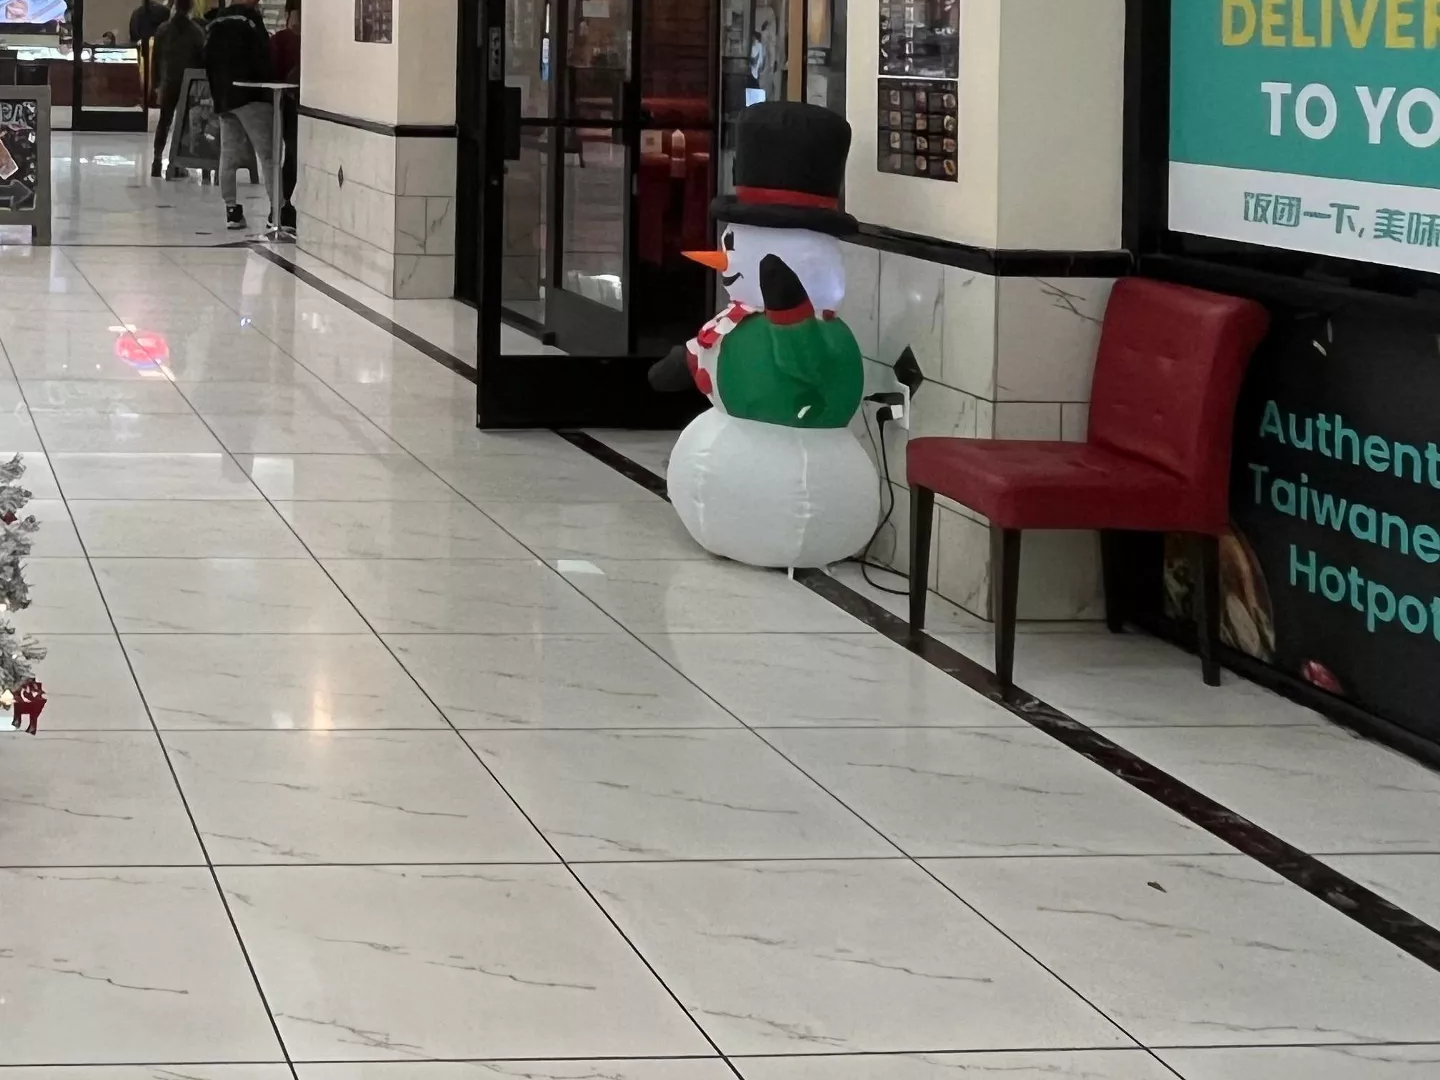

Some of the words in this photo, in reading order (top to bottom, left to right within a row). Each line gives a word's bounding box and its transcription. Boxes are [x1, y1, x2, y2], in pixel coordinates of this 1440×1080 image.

[1260, 81, 1338, 141] TO
[1355, 86, 1440, 149] YO
[1248, 463, 1440, 565] Taiwane
